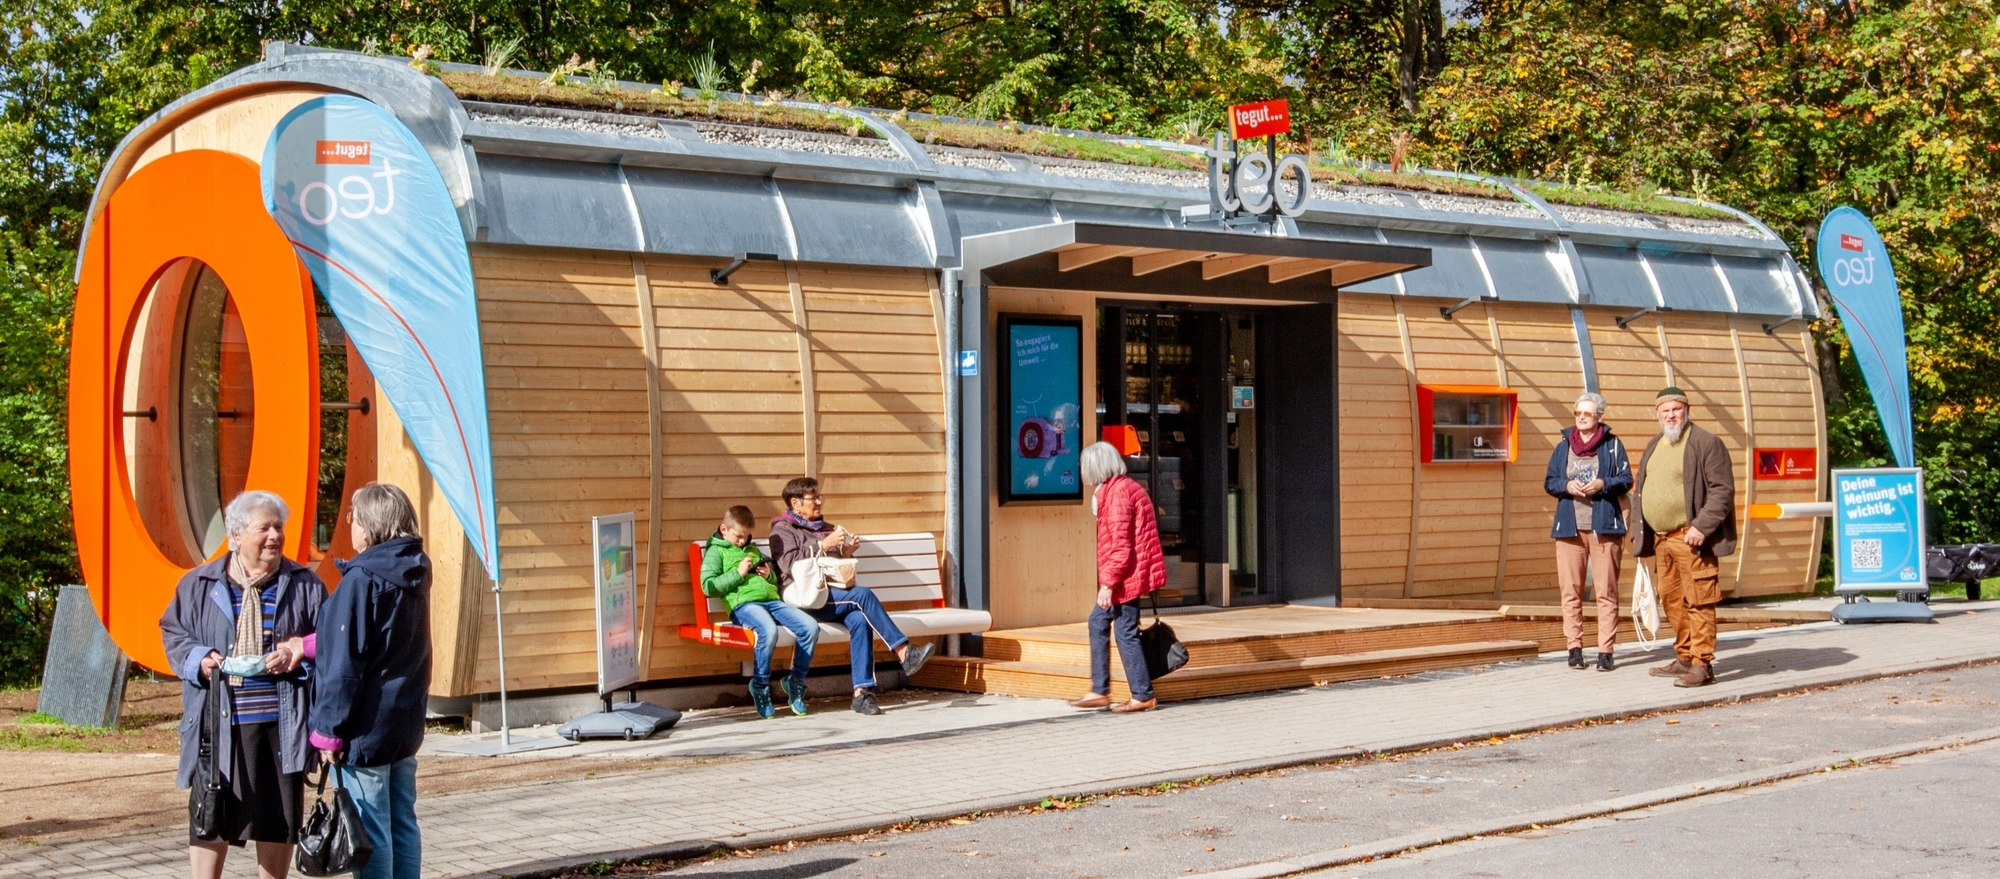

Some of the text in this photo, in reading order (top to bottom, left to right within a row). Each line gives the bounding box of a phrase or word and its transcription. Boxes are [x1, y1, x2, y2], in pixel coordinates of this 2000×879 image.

[1236, 105, 1283, 128] tegut...
[1205, 130, 1312, 218] teo
[1015, 335, 1051, 347] So engagiere
[1027, 345, 1041, 355] mich
[1041, 343, 1049, 352] für
[1050, 342, 1059, 350] die
[1018, 356, 1040, 367] Umwelt
[1060, 475, 1075, 485] teo
[1841, 477, 1876, 492] Deine
[1844, 482, 1914, 506] Meinung ist
[1847, 501, 1895, 519] wichtig.
[1900, 570, 1917, 580] teo
